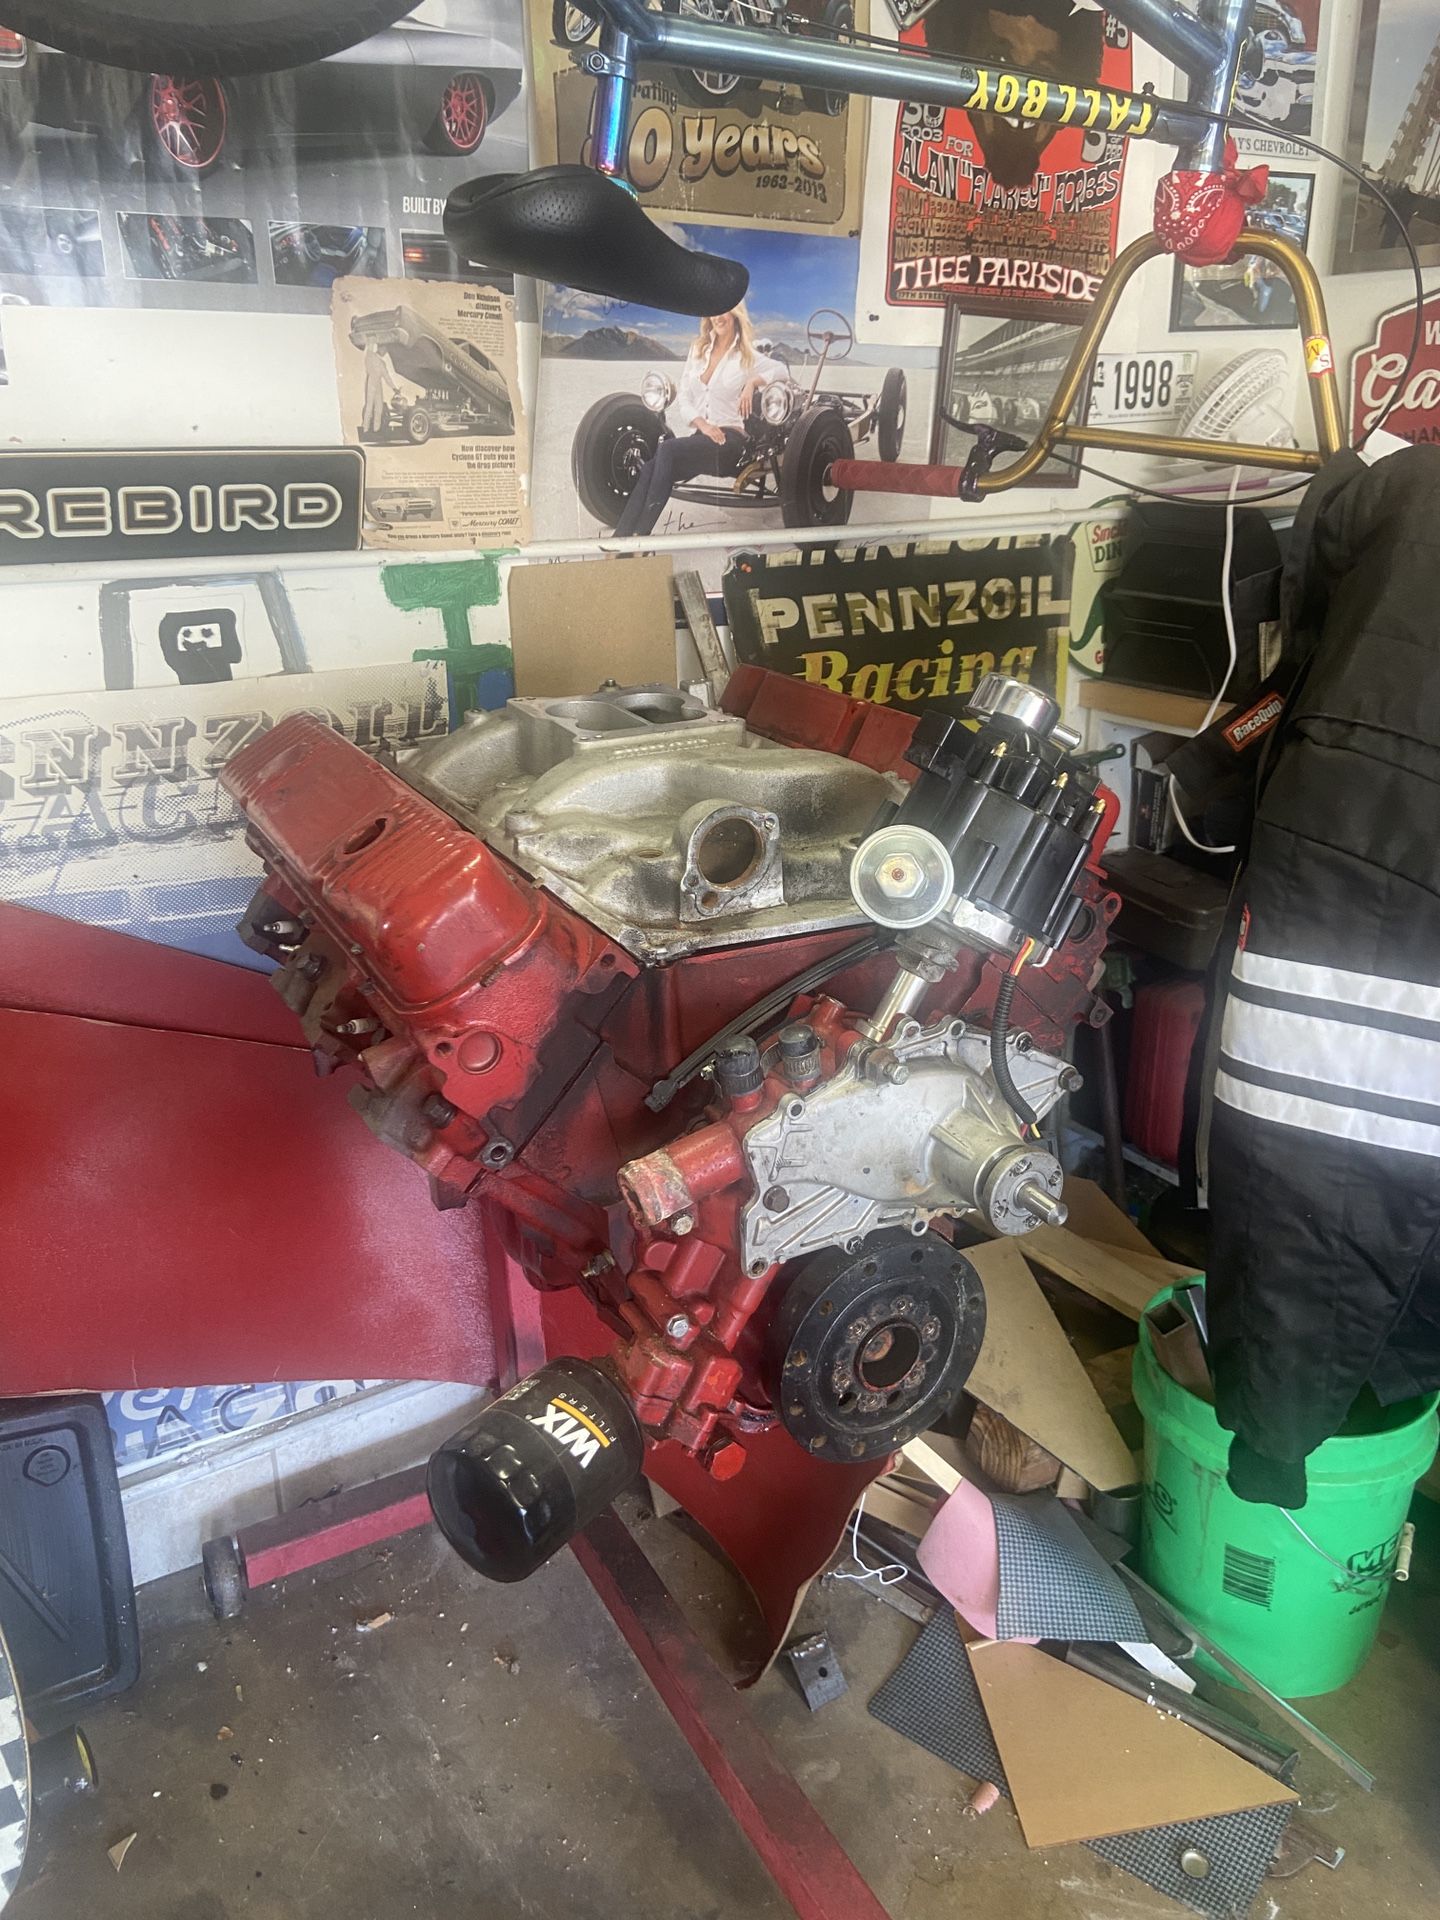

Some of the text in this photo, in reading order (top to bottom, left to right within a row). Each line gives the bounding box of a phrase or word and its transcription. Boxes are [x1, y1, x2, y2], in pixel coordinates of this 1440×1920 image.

[680, 115, 826, 183] years
[946, 135, 973, 157] FOR
[403, 196, 447, 216] BUILT BY
[755, 174, 828, 204] 1963-2013
[893, 255, 971, 291] THEE
[976, 257, 1104, 301] PARKSIDE
[1112, 359, 1174, 411] 1998
[756, 575, 1070, 644] PENNZOIL
[529, 1403, 601, 1469] WIX
[558, 1392, 617, 1443] FILTERS
